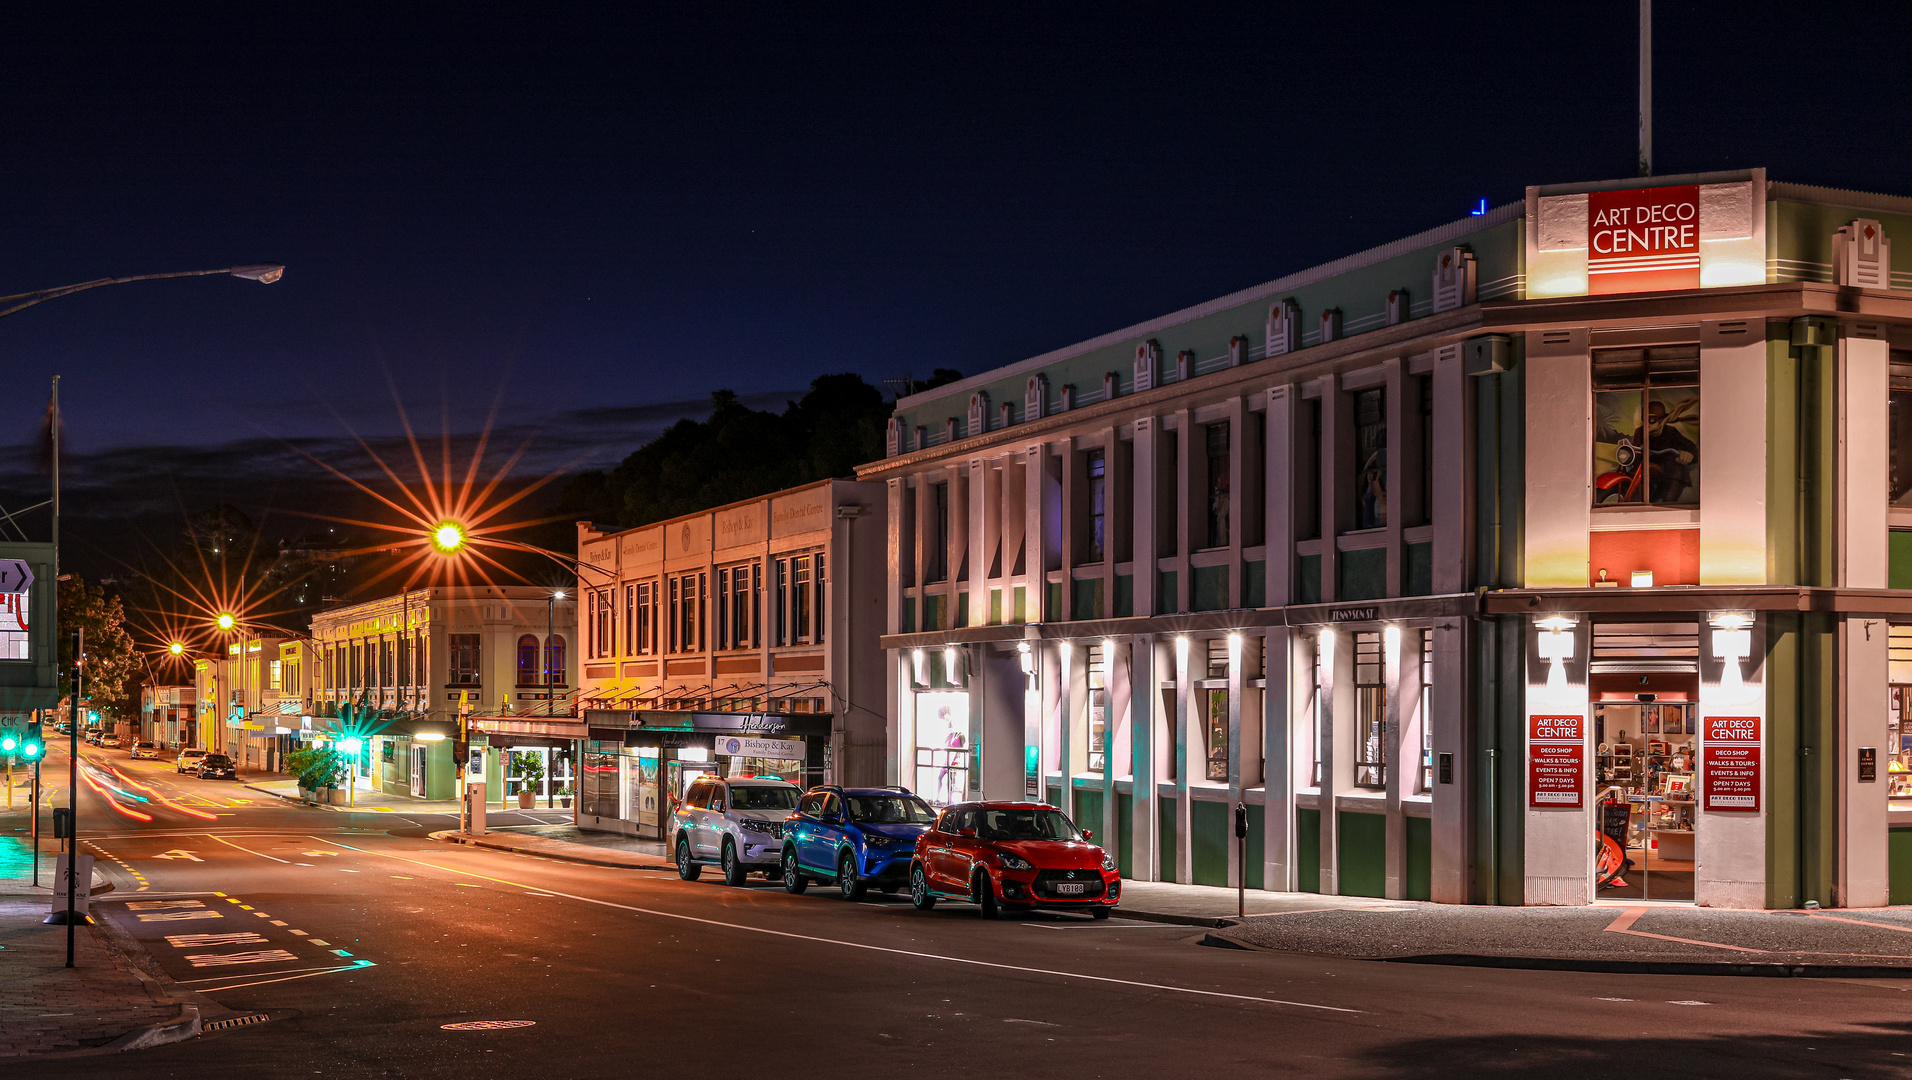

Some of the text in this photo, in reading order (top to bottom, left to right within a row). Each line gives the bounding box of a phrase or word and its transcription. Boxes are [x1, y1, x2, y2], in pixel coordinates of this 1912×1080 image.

[1593, 202, 1695, 227] ART DECO
[1593, 224, 1694, 254] CENTRE
[1332, 608, 1374, 620] TENNYSON ST
[1, 716, 19, 727] CHIC
[740, 712, 786, 734] Henderson
[1537, 718, 1578, 727] ART DECO
[1711, 720, 1755, 728] ART DECO
[1537, 727, 1577, 737] CENTRE
[1711, 728, 1754, 739] CENTRE
[717, 738, 725, 746] 17
[744, 739, 795, 753] Bishop & Kay
